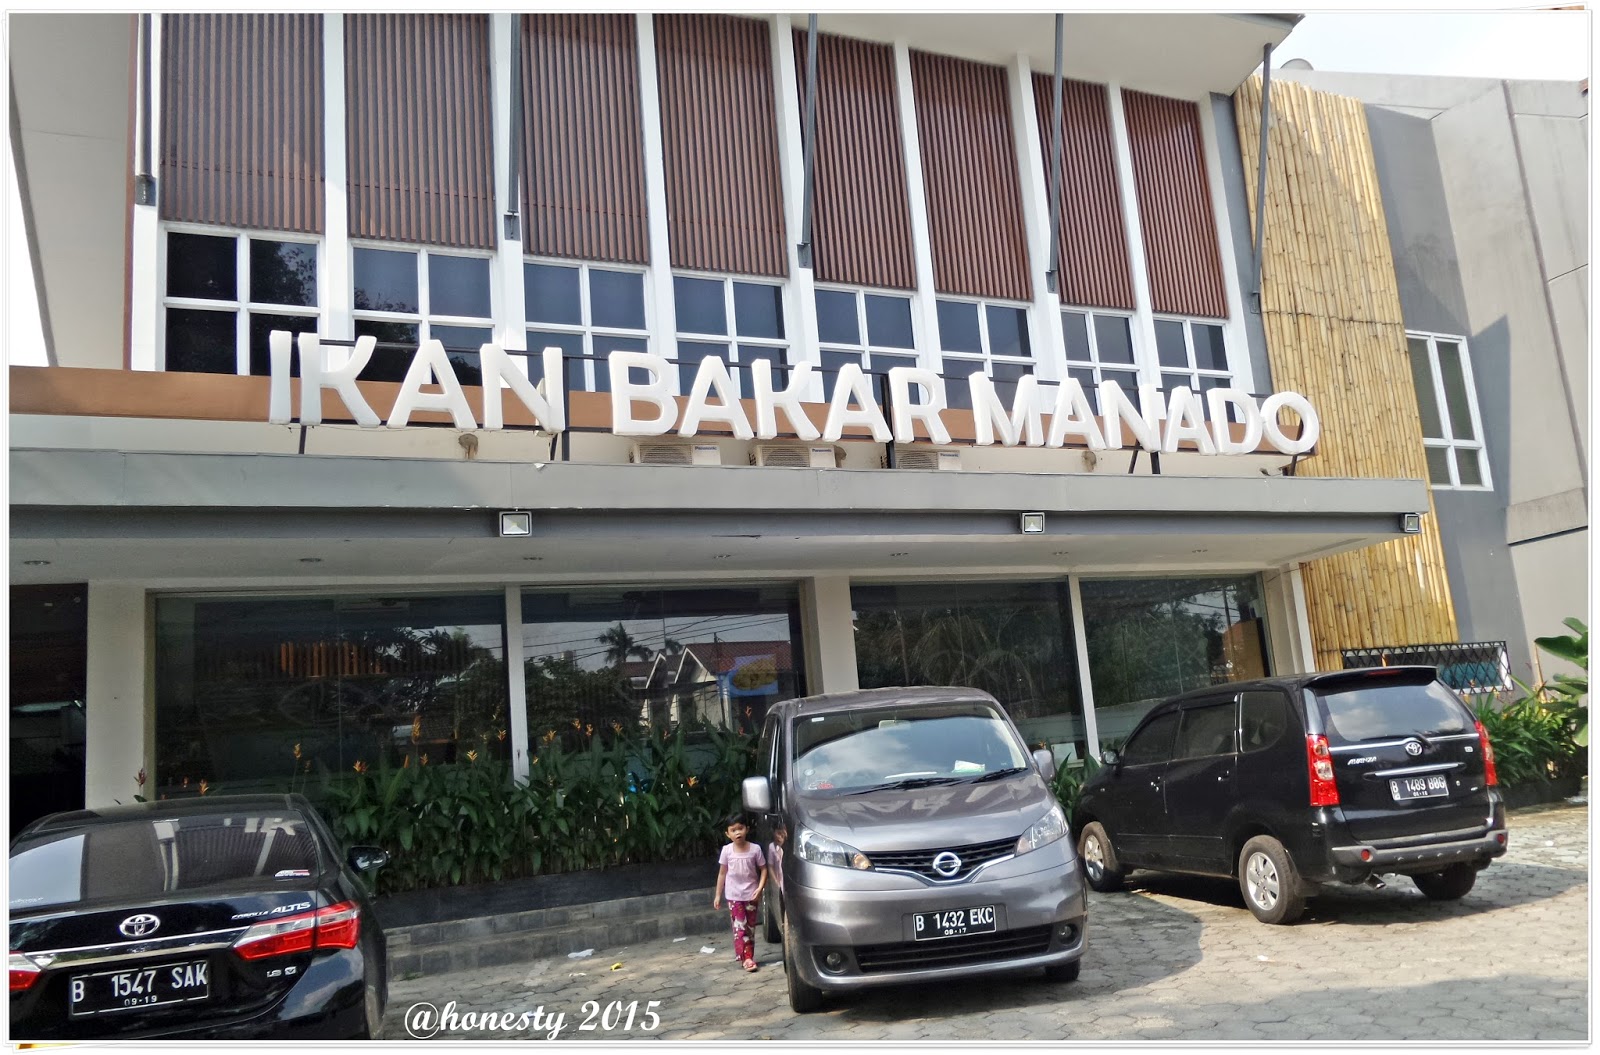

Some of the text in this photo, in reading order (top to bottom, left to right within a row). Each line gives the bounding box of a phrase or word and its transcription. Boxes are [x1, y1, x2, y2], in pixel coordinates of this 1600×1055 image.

[268, 330, 1319, 456] IKAN BAKAR MANADO
[1391, 780, 1399, 793] B
[270, 901, 312, 914] ALTIS
[915, 907, 994, 932] B 1432 EKC
[72, 963, 208, 1003] B 1547 SAK
[124, 995, 158, 1007] 09-19
